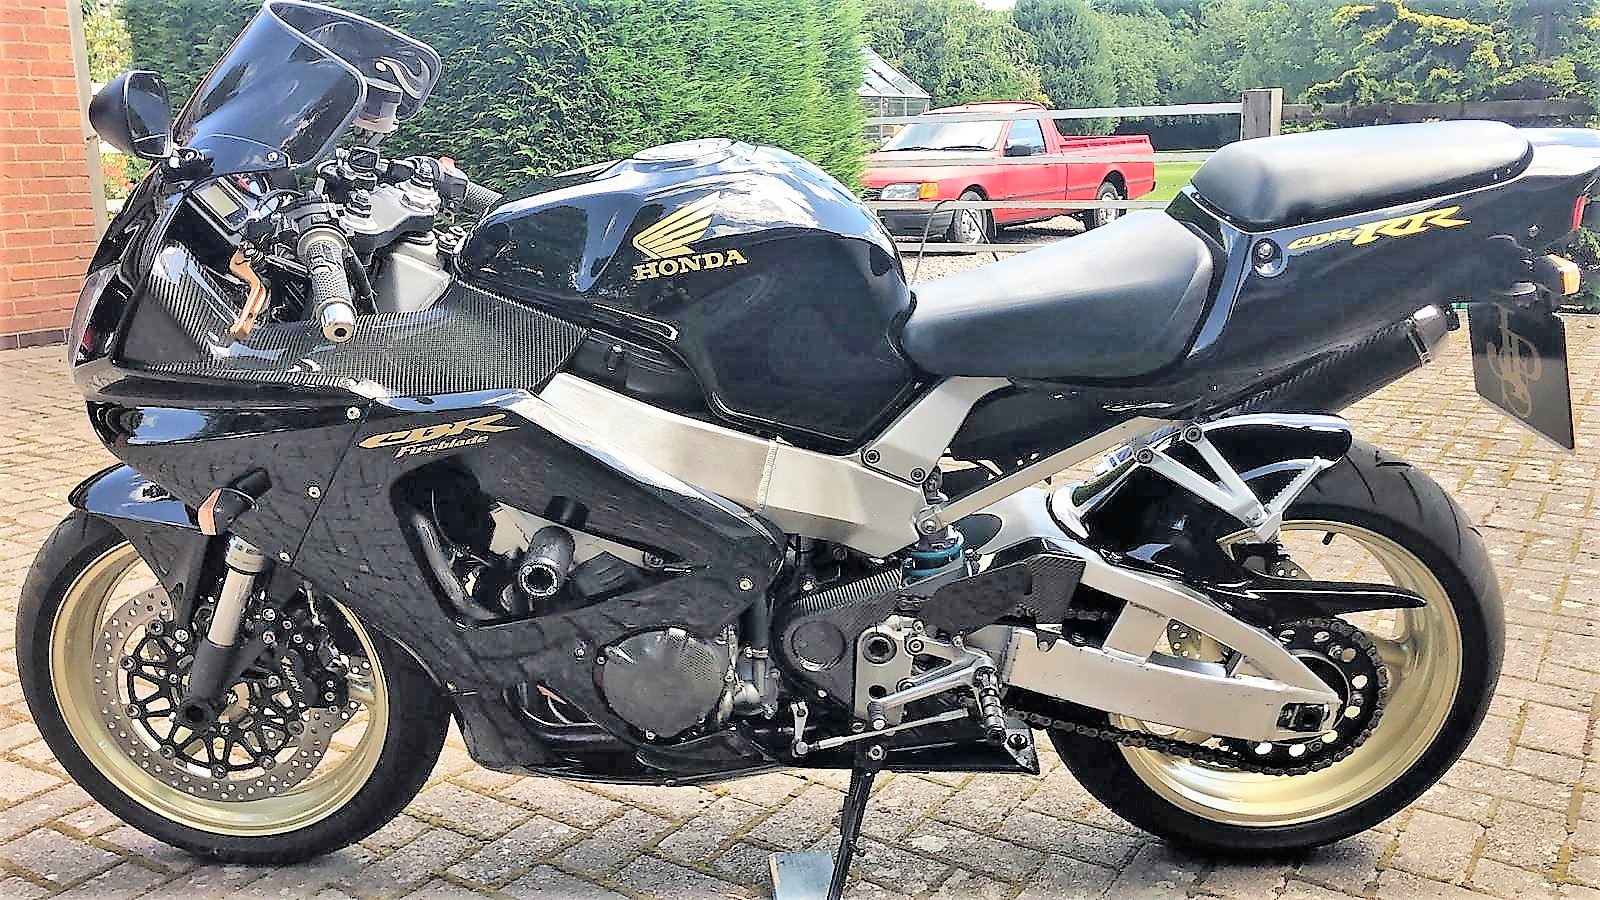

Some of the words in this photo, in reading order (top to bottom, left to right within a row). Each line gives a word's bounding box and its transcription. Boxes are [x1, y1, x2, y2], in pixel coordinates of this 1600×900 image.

[633, 249, 747, 280] HONDA
[359, 413, 520, 448] CBR
[394, 434, 489, 459] Fireblade
